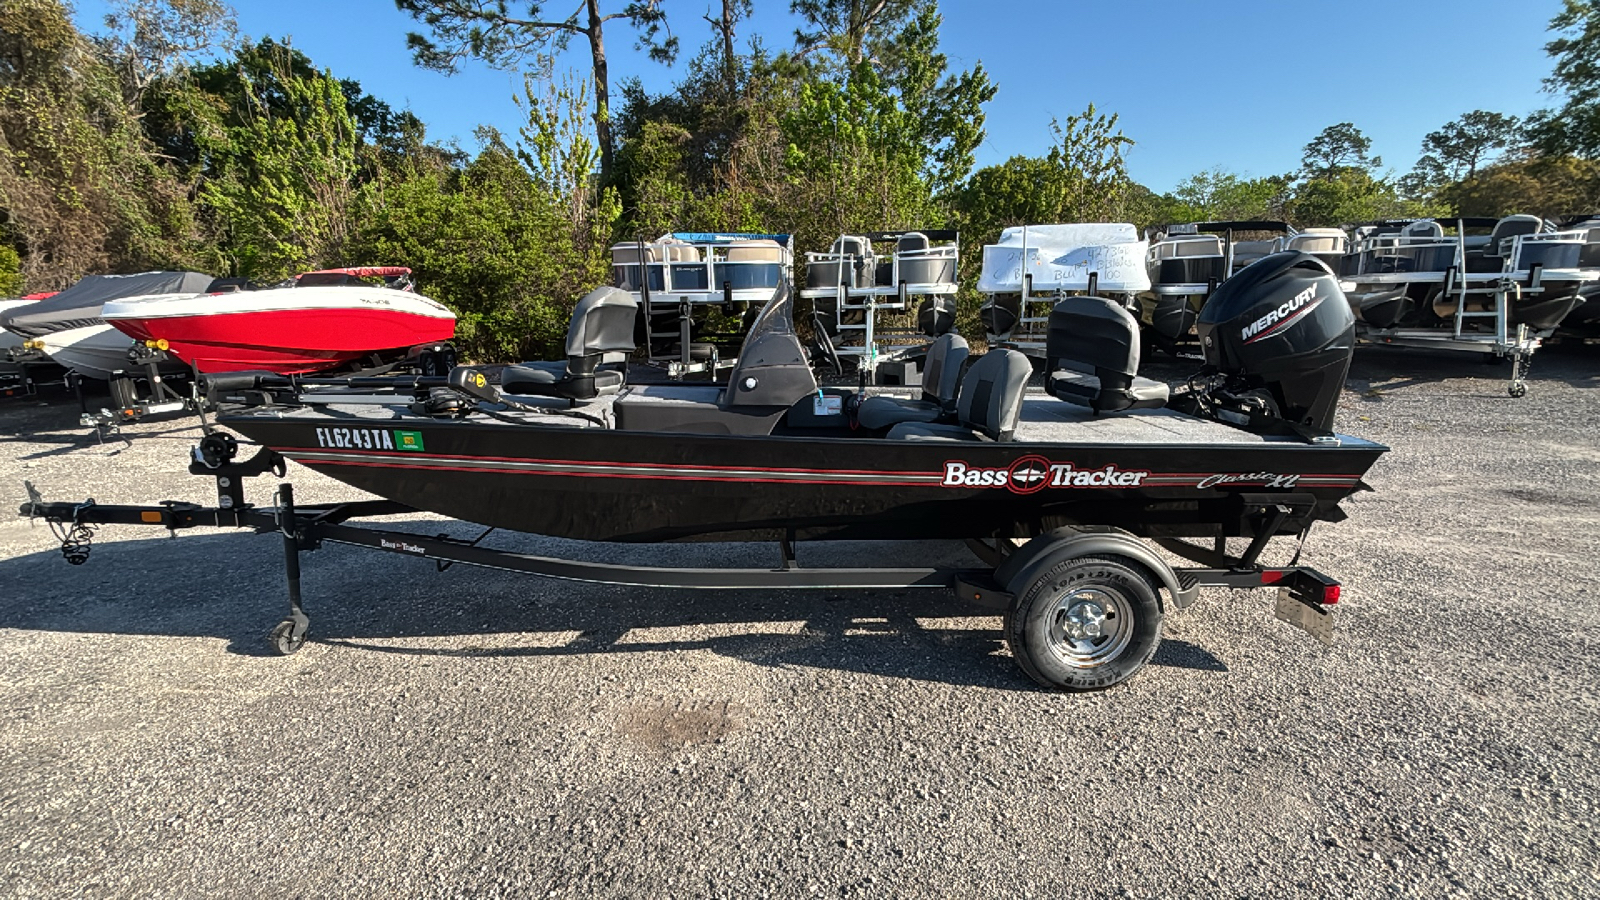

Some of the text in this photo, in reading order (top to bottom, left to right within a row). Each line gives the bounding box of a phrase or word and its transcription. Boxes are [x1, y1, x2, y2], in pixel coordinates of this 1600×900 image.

[1241, 281, 1318, 341] MERCURY
[315, 427, 394, 450] FL6243TA
[943, 462, 1148, 486] Bass Tracker
[1196, 471, 1301, 489] Classic XL
[401, 542, 426, 554] Tracker
